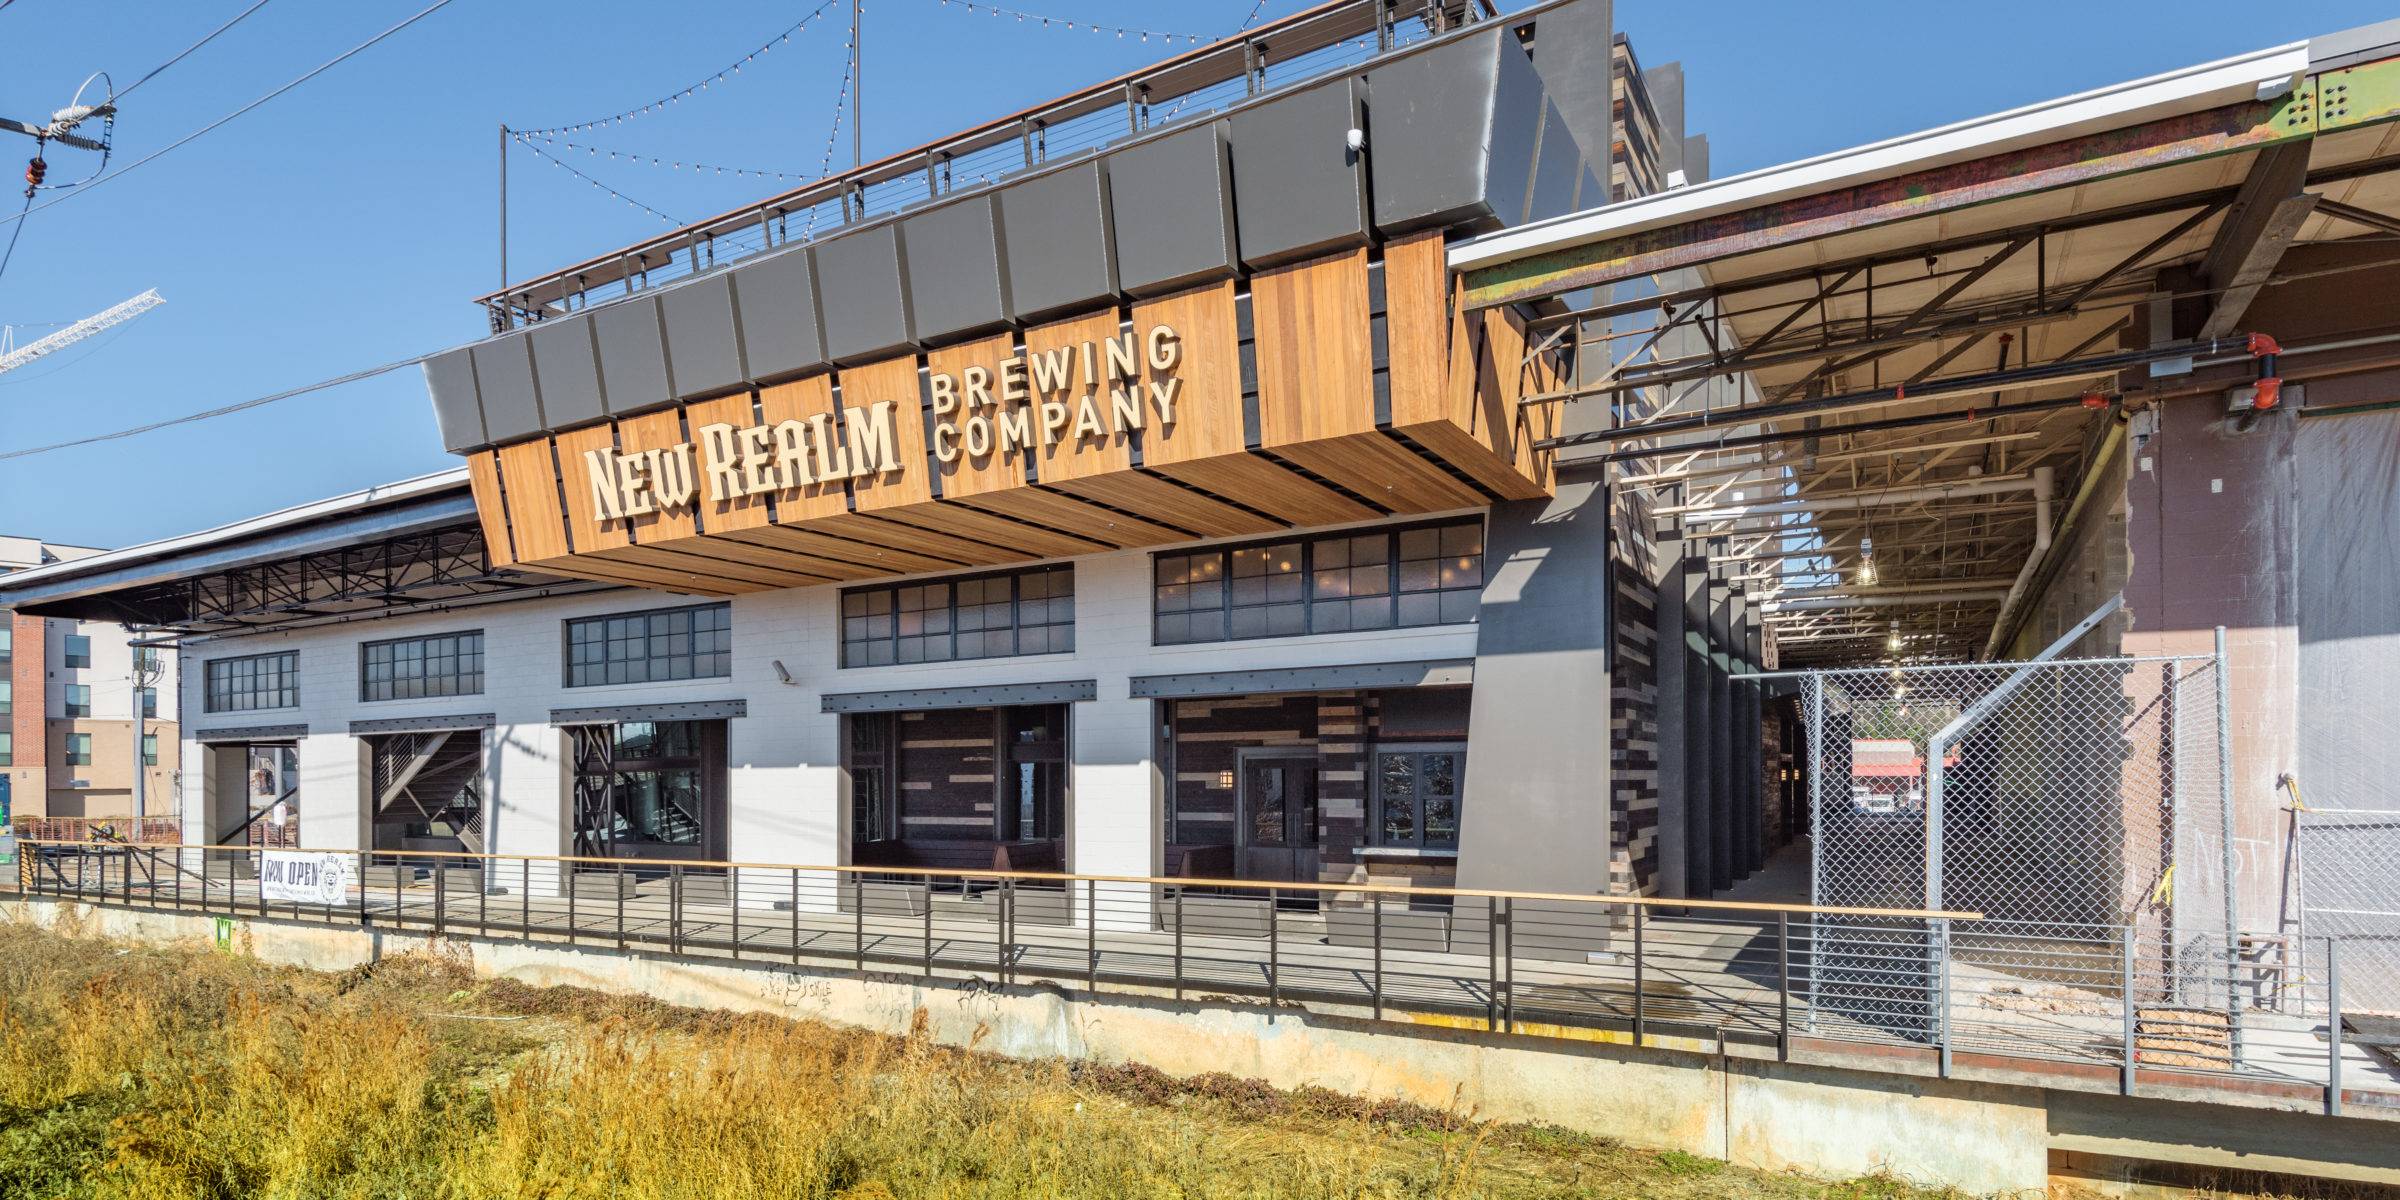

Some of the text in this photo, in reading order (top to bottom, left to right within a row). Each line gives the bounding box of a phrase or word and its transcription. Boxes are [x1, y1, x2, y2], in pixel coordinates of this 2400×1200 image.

[930, 325, 1182, 414] BREWING
[585, 400, 904, 521] NEW REALM
[934, 377, 1183, 462] COMPANY
[288, 861, 318, 887] OPEN
